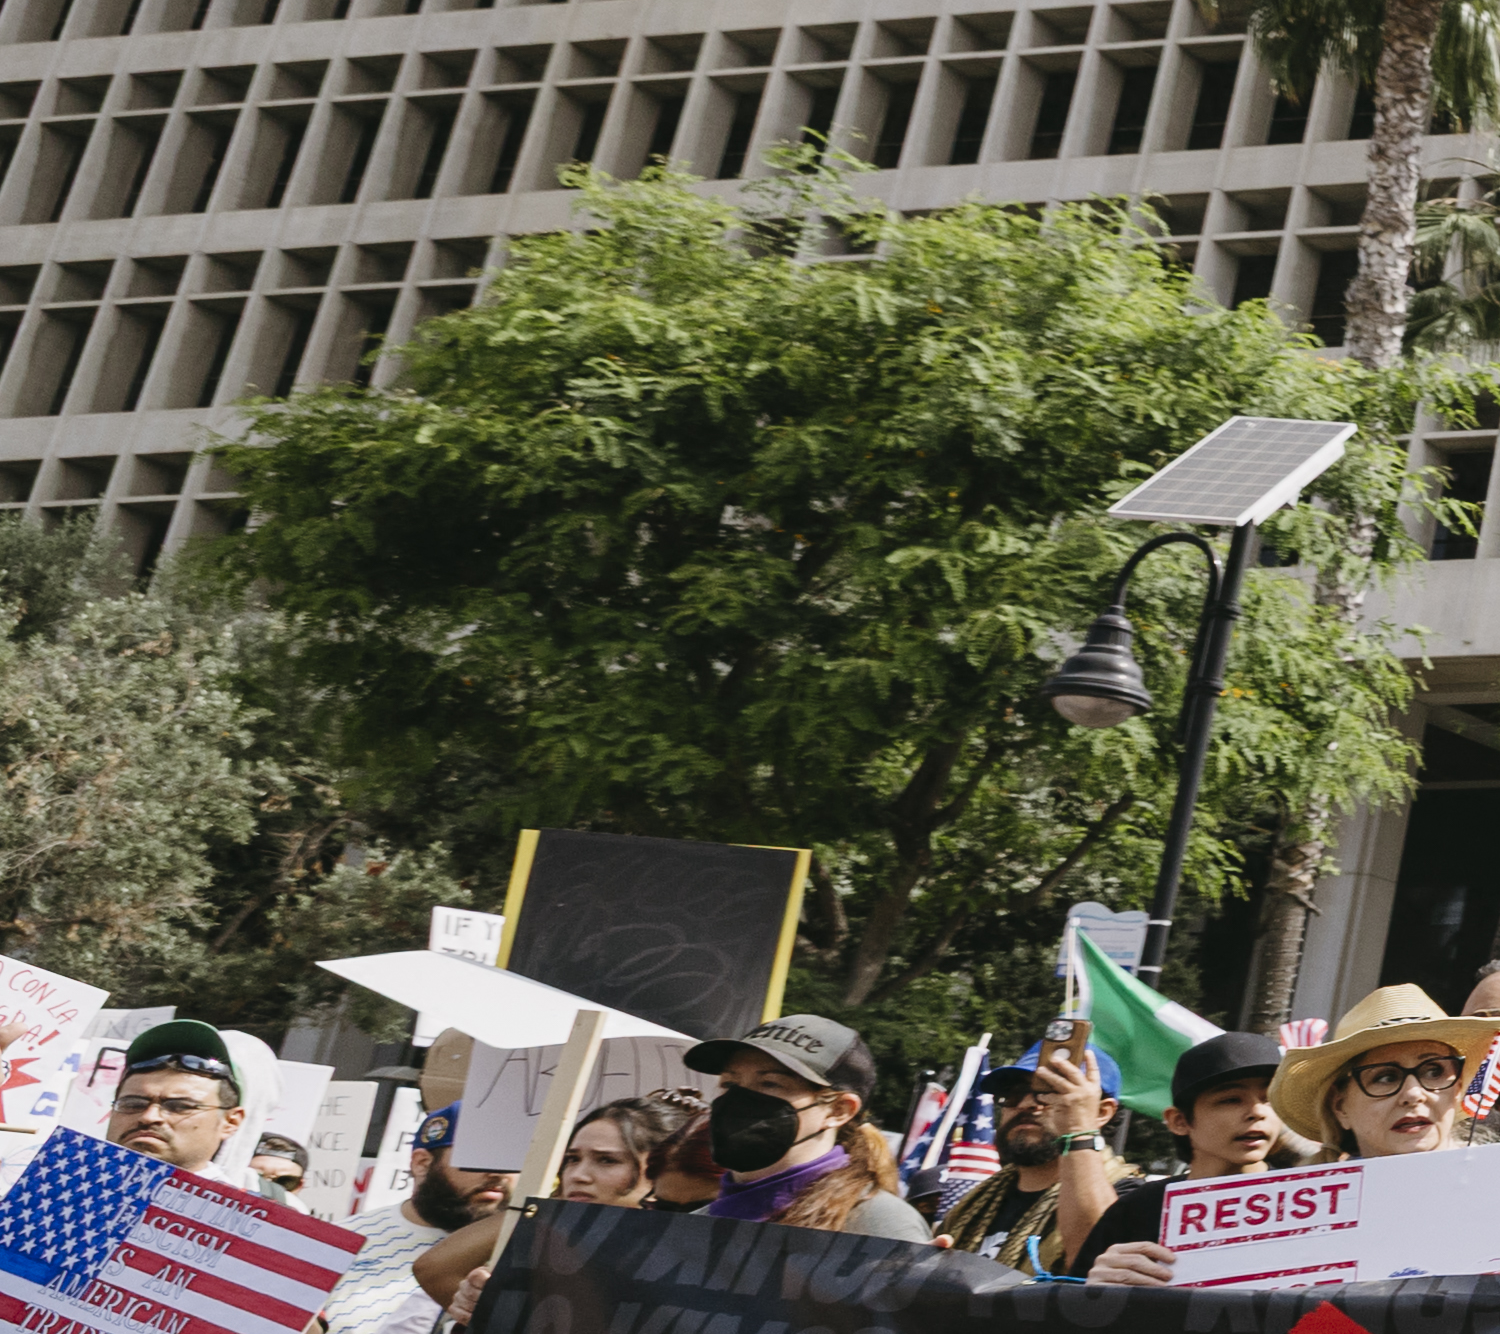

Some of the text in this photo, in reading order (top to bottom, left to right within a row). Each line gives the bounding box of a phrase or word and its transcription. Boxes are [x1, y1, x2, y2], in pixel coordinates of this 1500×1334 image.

[119, 1163, 268, 1238] FIGHTING
[1179, 1182, 1350, 1236] RESIST
[107, 1202, 232, 1270] FASCISM
[100, 1244, 197, 1301] IS AN
